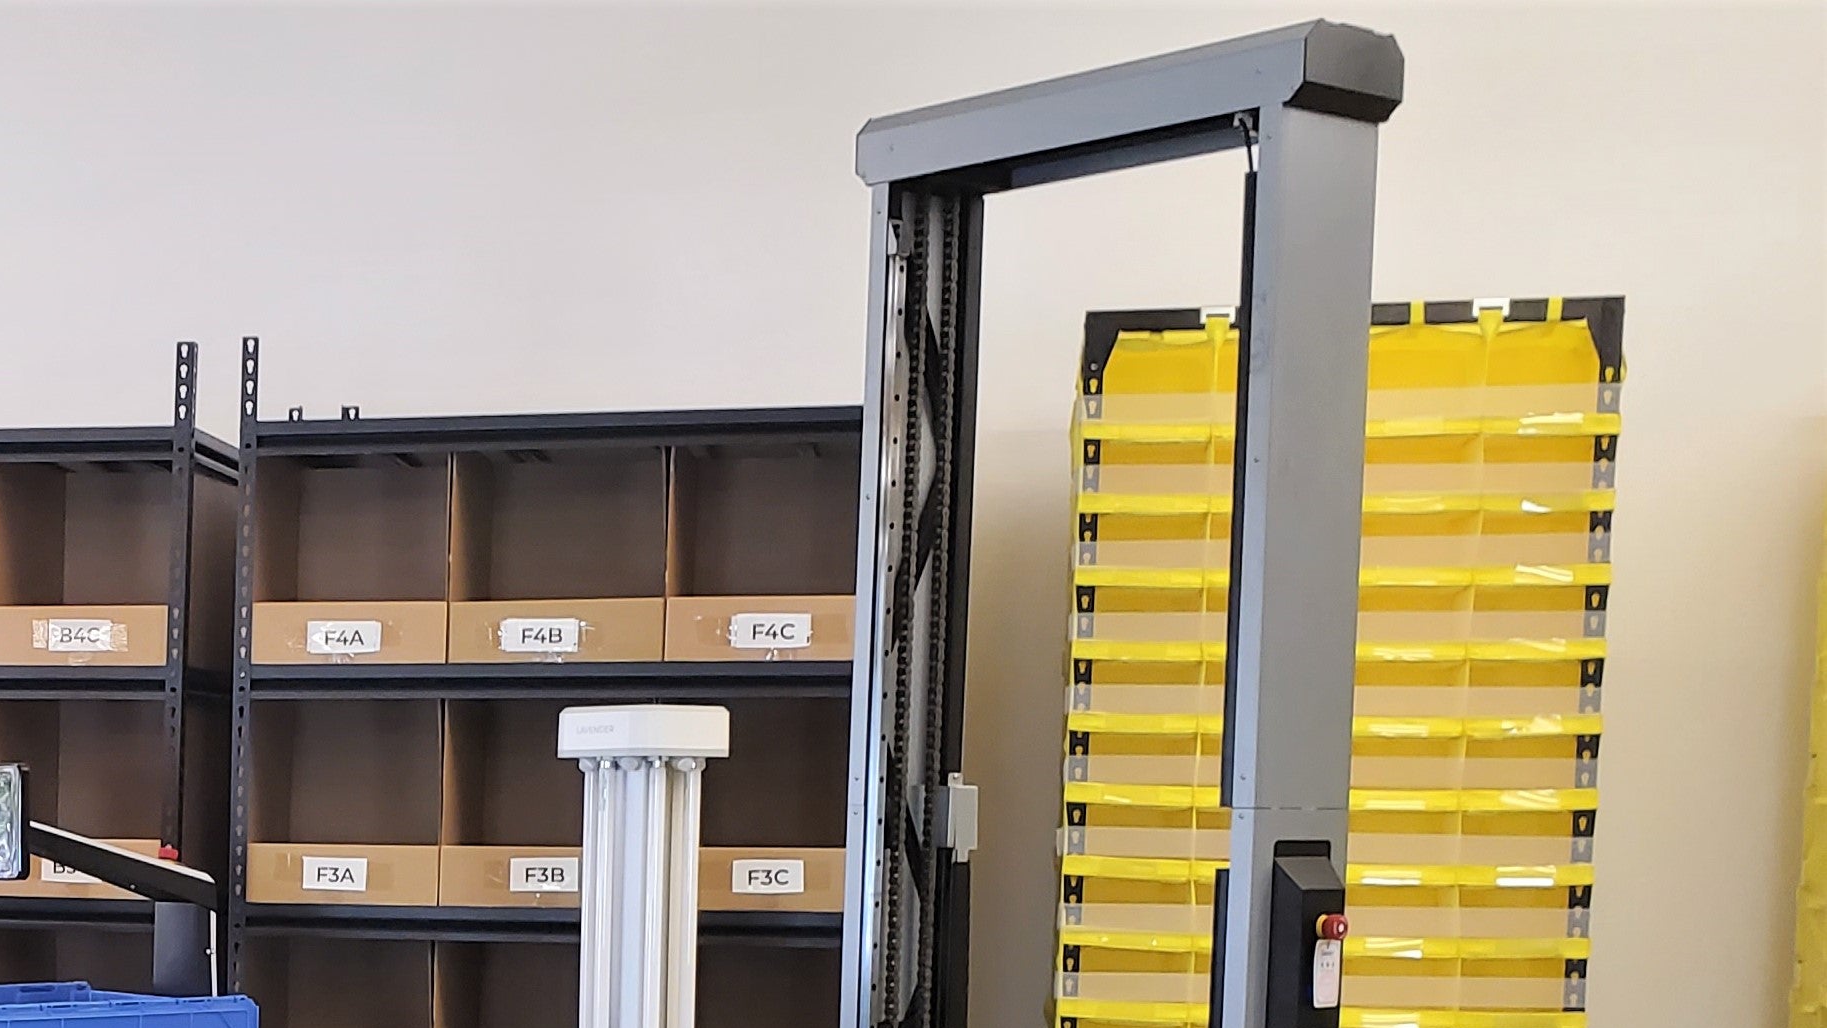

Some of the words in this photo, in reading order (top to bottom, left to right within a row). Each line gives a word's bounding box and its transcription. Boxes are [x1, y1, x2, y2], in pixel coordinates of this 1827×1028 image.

[60, 627, 99, 643] B4C
[325, 630, 364, 645] F4A
[522, 628, 562, 644] F4B
[753, 624, 795, 640] F4C
[317, 867, 354, 883] F3A
[526, 868, 564, 882] F3B
[749, 869, 788, 885] F3C
